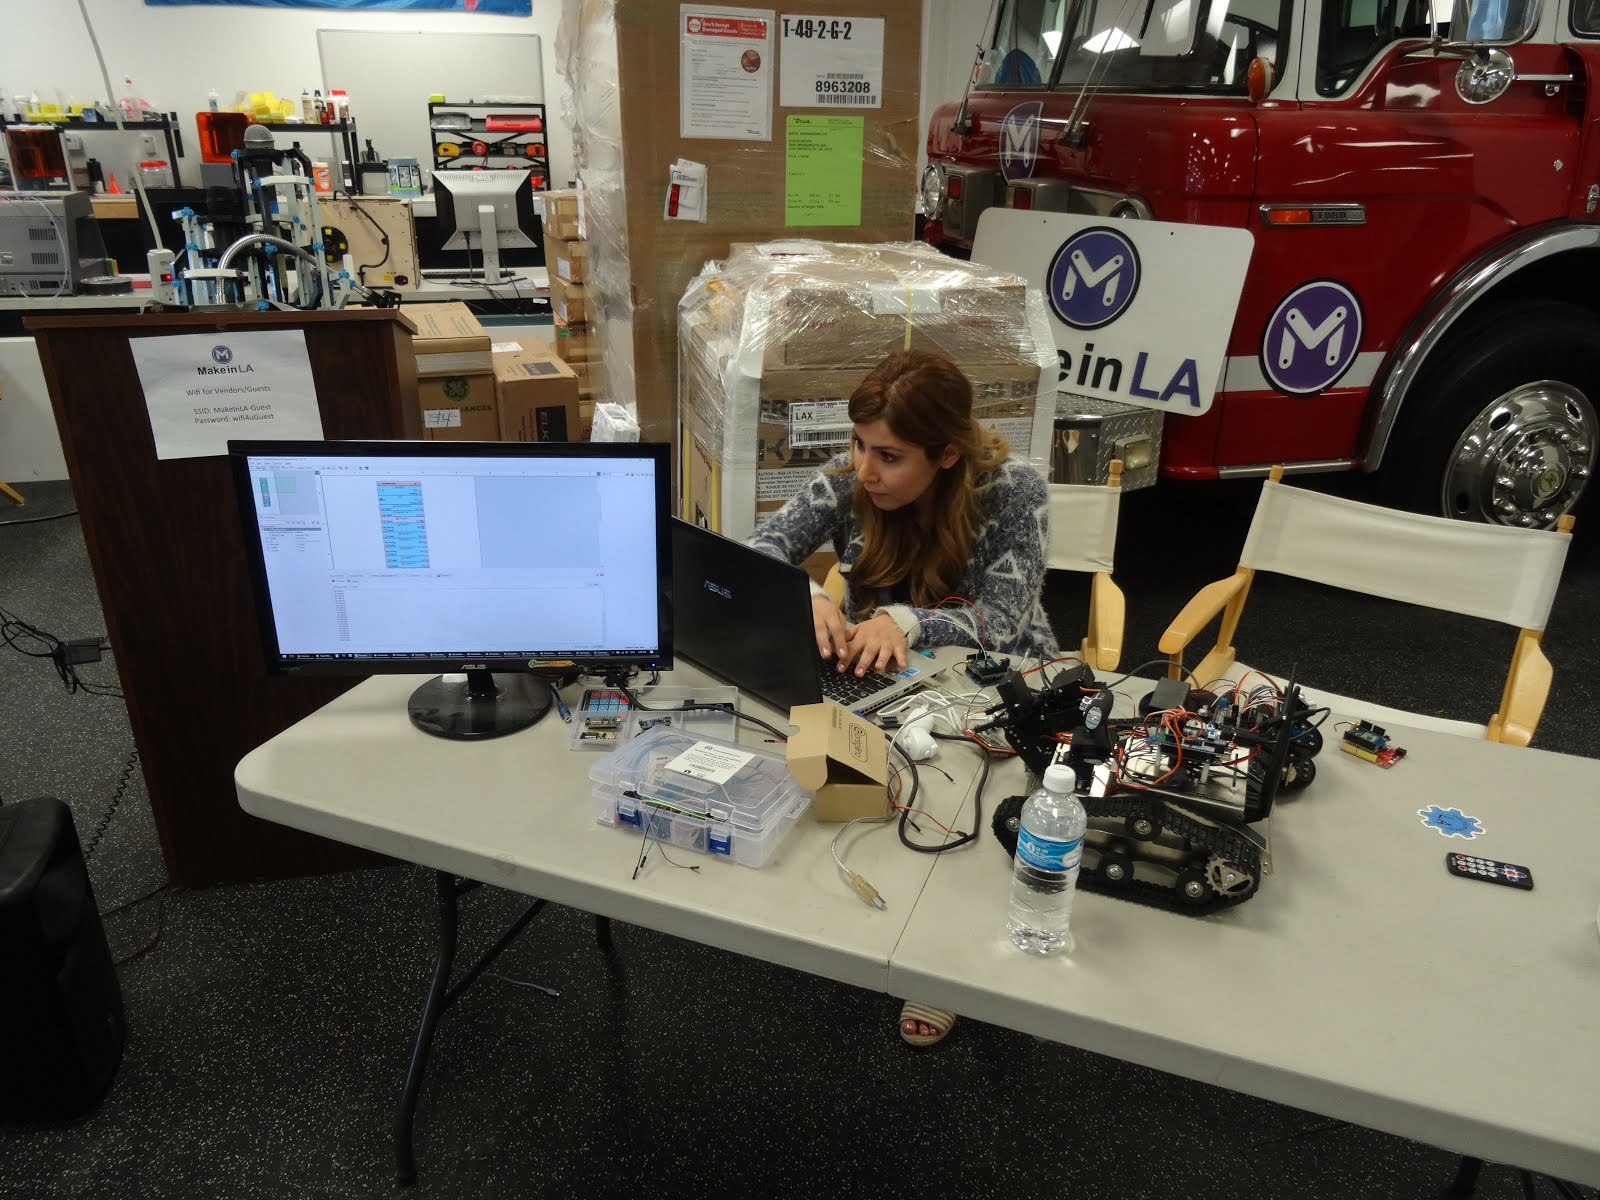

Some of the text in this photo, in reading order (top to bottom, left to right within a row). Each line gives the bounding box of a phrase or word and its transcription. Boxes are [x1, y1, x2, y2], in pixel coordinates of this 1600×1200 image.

[783, 18, 852, 40] T-49-2-G-2
[815, 80, 871, 94] 8963208
[1318, 211, 1347, 221] FORD
[185, 385, 272, 396] Wifi for Vendors/Guests
[193, 407, 212, 415] SSID:
[795, 411, 813, 421] LAX
[194, 416, 231, 424] Password:
[703, 579, 732, 600] ASUS
